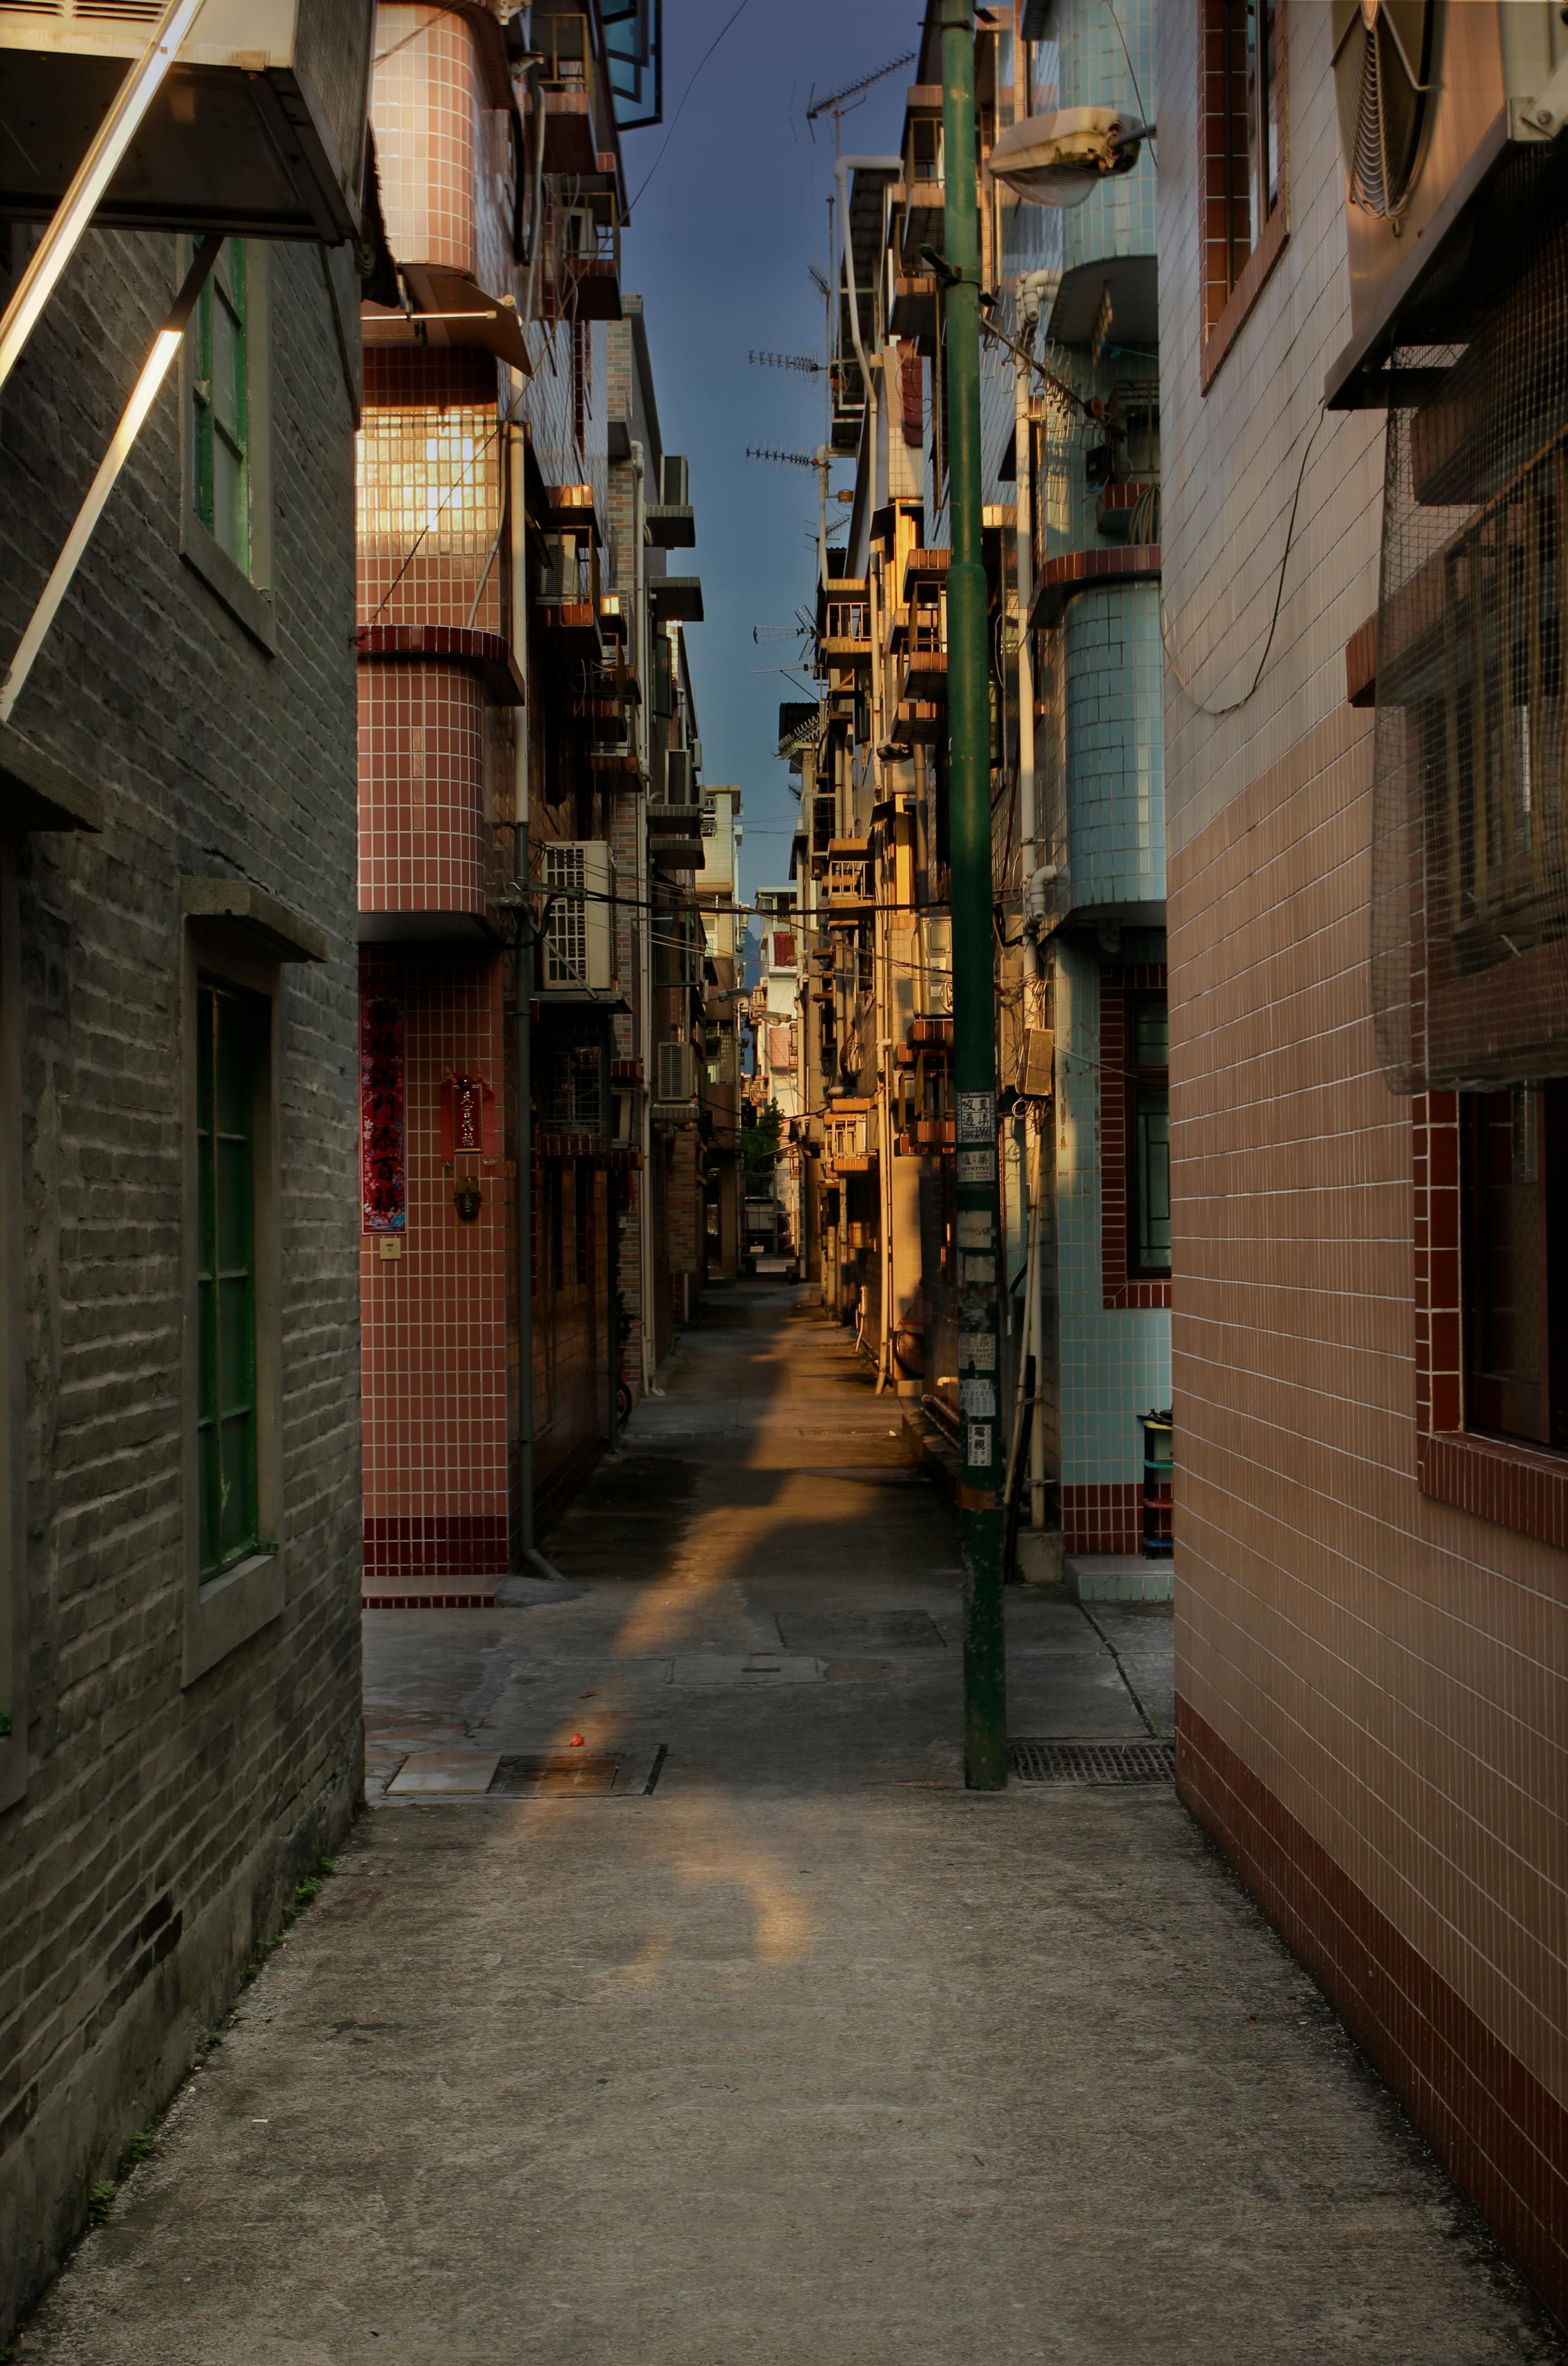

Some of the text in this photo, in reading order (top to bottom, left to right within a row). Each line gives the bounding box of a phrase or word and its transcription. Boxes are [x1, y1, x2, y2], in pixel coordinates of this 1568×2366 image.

[460, 1091, 475, 1146] 天官賜福
[963, 1113, 989, 1126] 通渠
[974, 1427, 985, 1450] 電視
